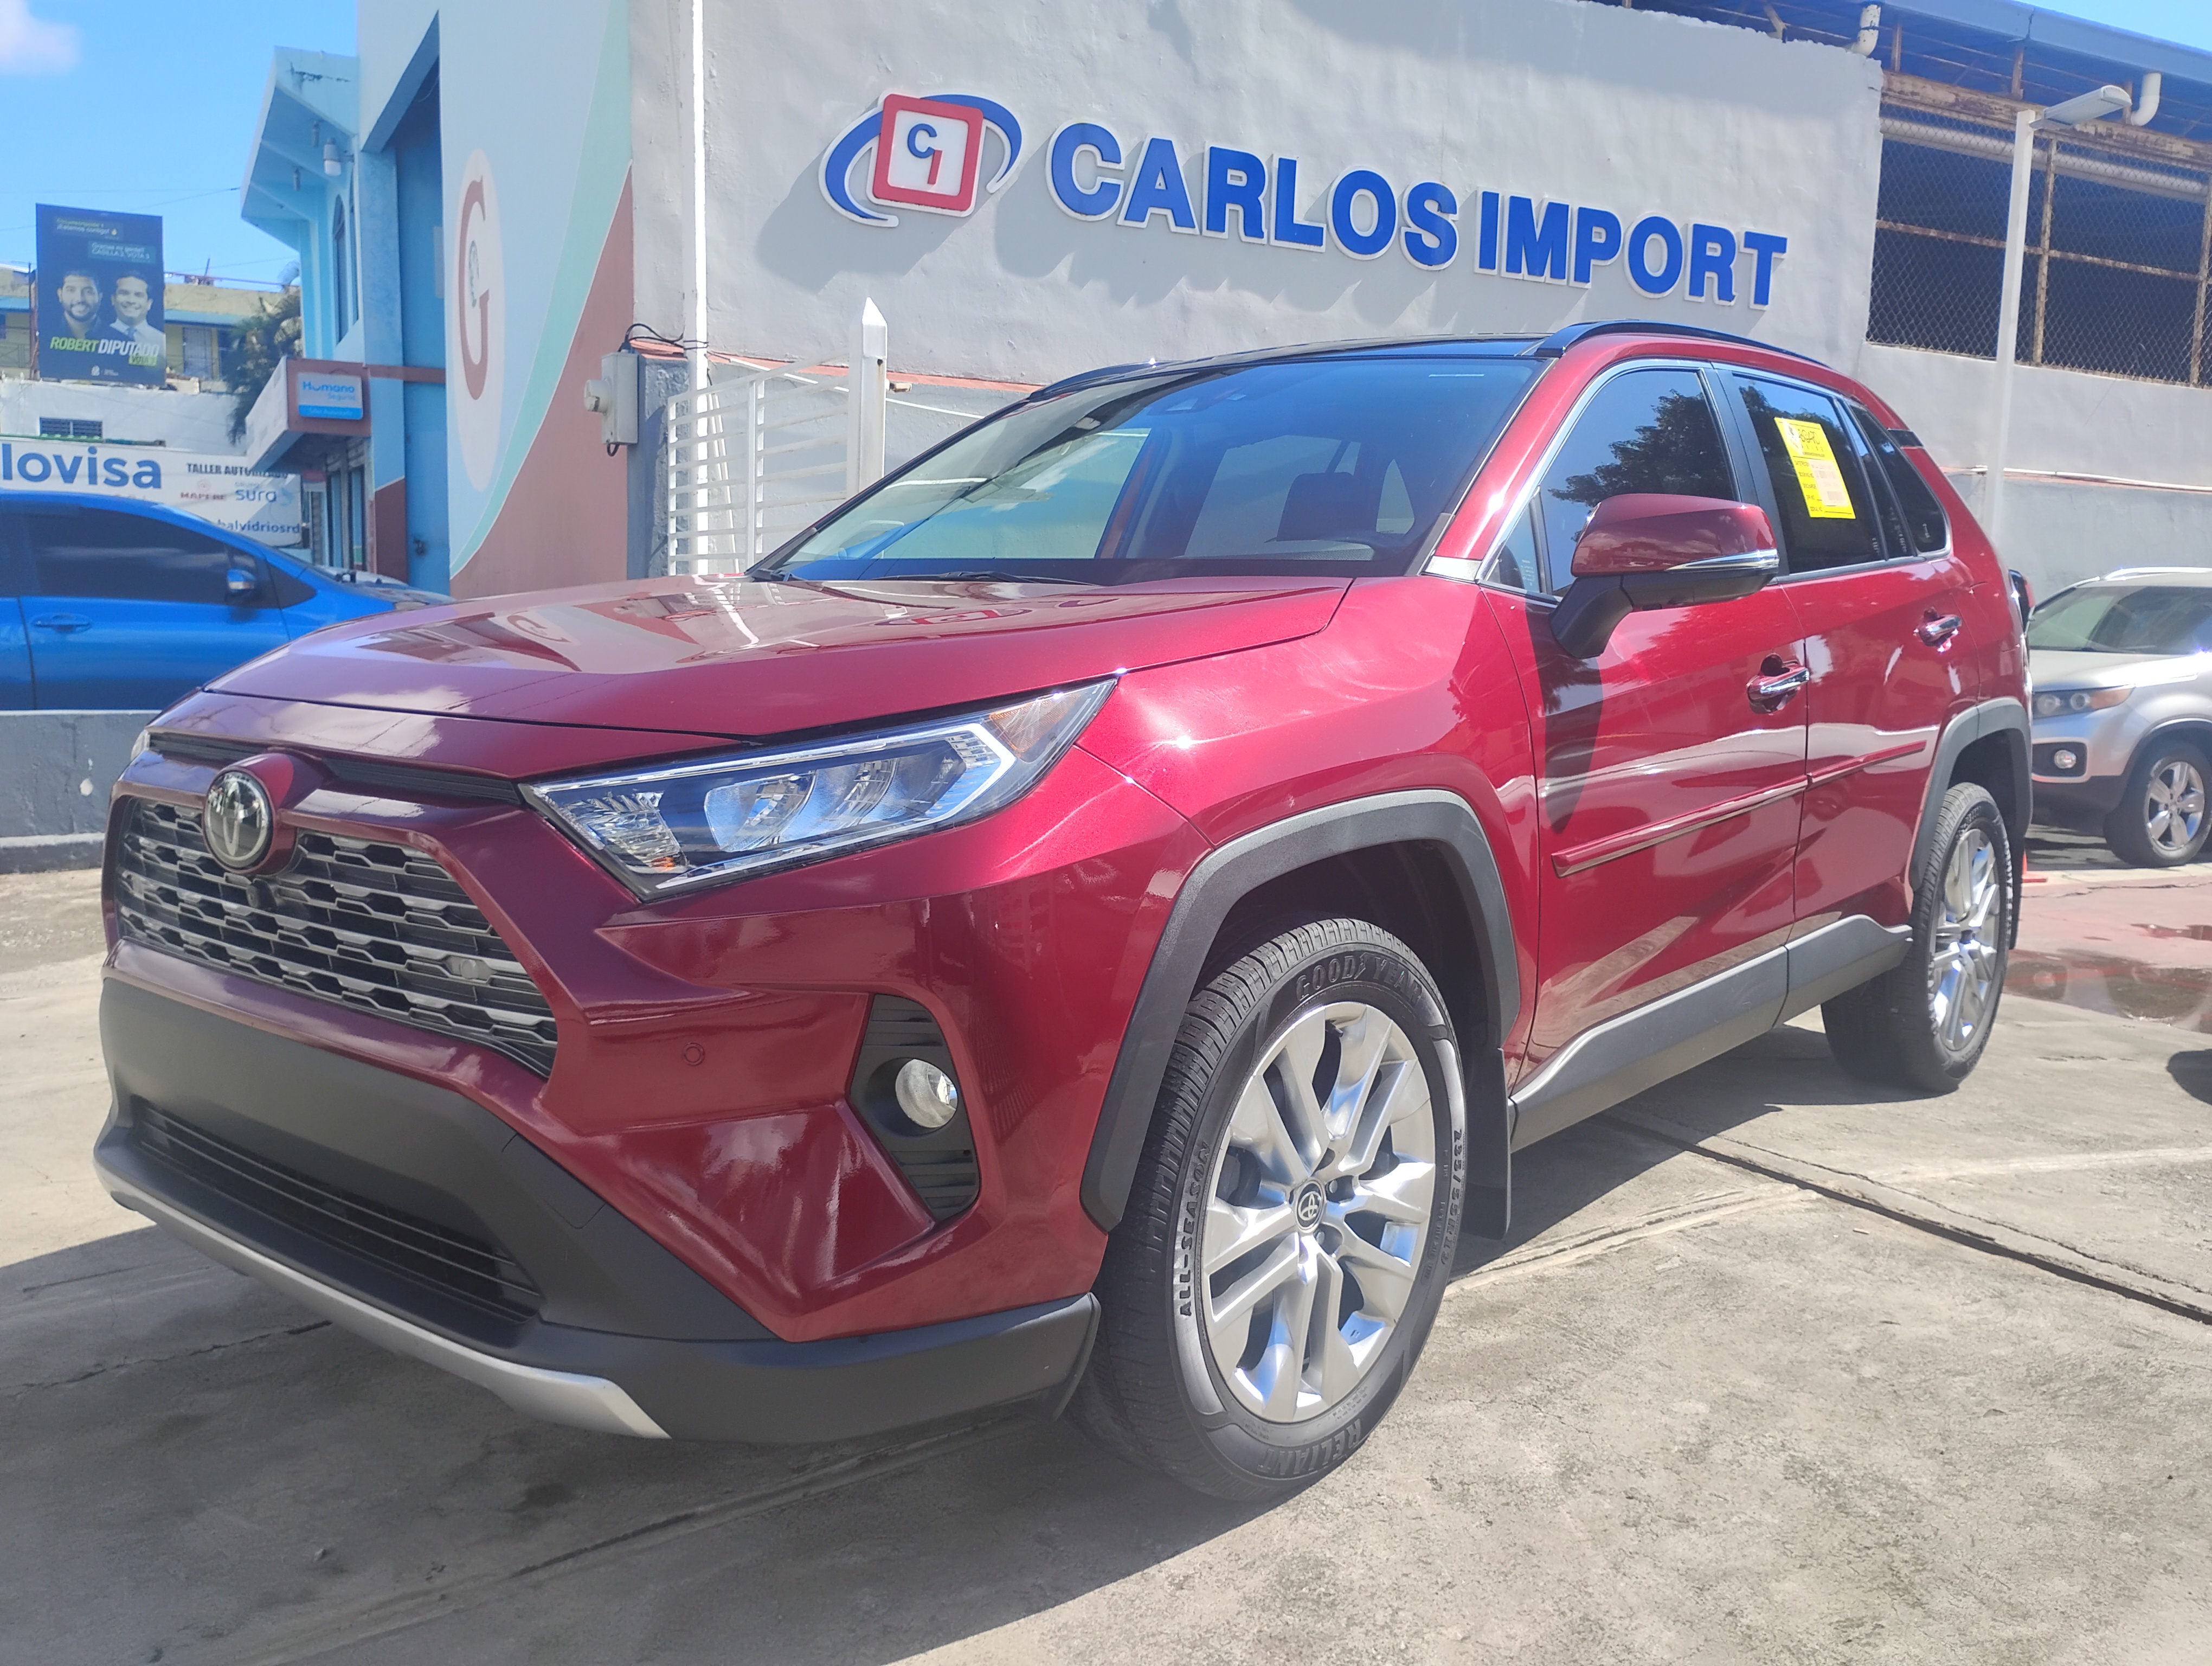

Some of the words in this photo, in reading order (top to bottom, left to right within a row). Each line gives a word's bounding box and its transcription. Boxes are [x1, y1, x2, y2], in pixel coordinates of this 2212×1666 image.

[1051, 122, 1458, 267] CARLOS
[1478, 190, 1789, 306] IMPORT
[50, 336, 100, 353] ROBERT
[98, 339, 160, 357] DIPUTADO
[303, 381, 355, 393] Humano
[187, 463, 221, 474] TALLER
[235, 489, 278, 503] sura
[1179, 1140, 1211, 1317] ALL-SEASON
[1257, 1419, 1361, 1476] RELIANT
